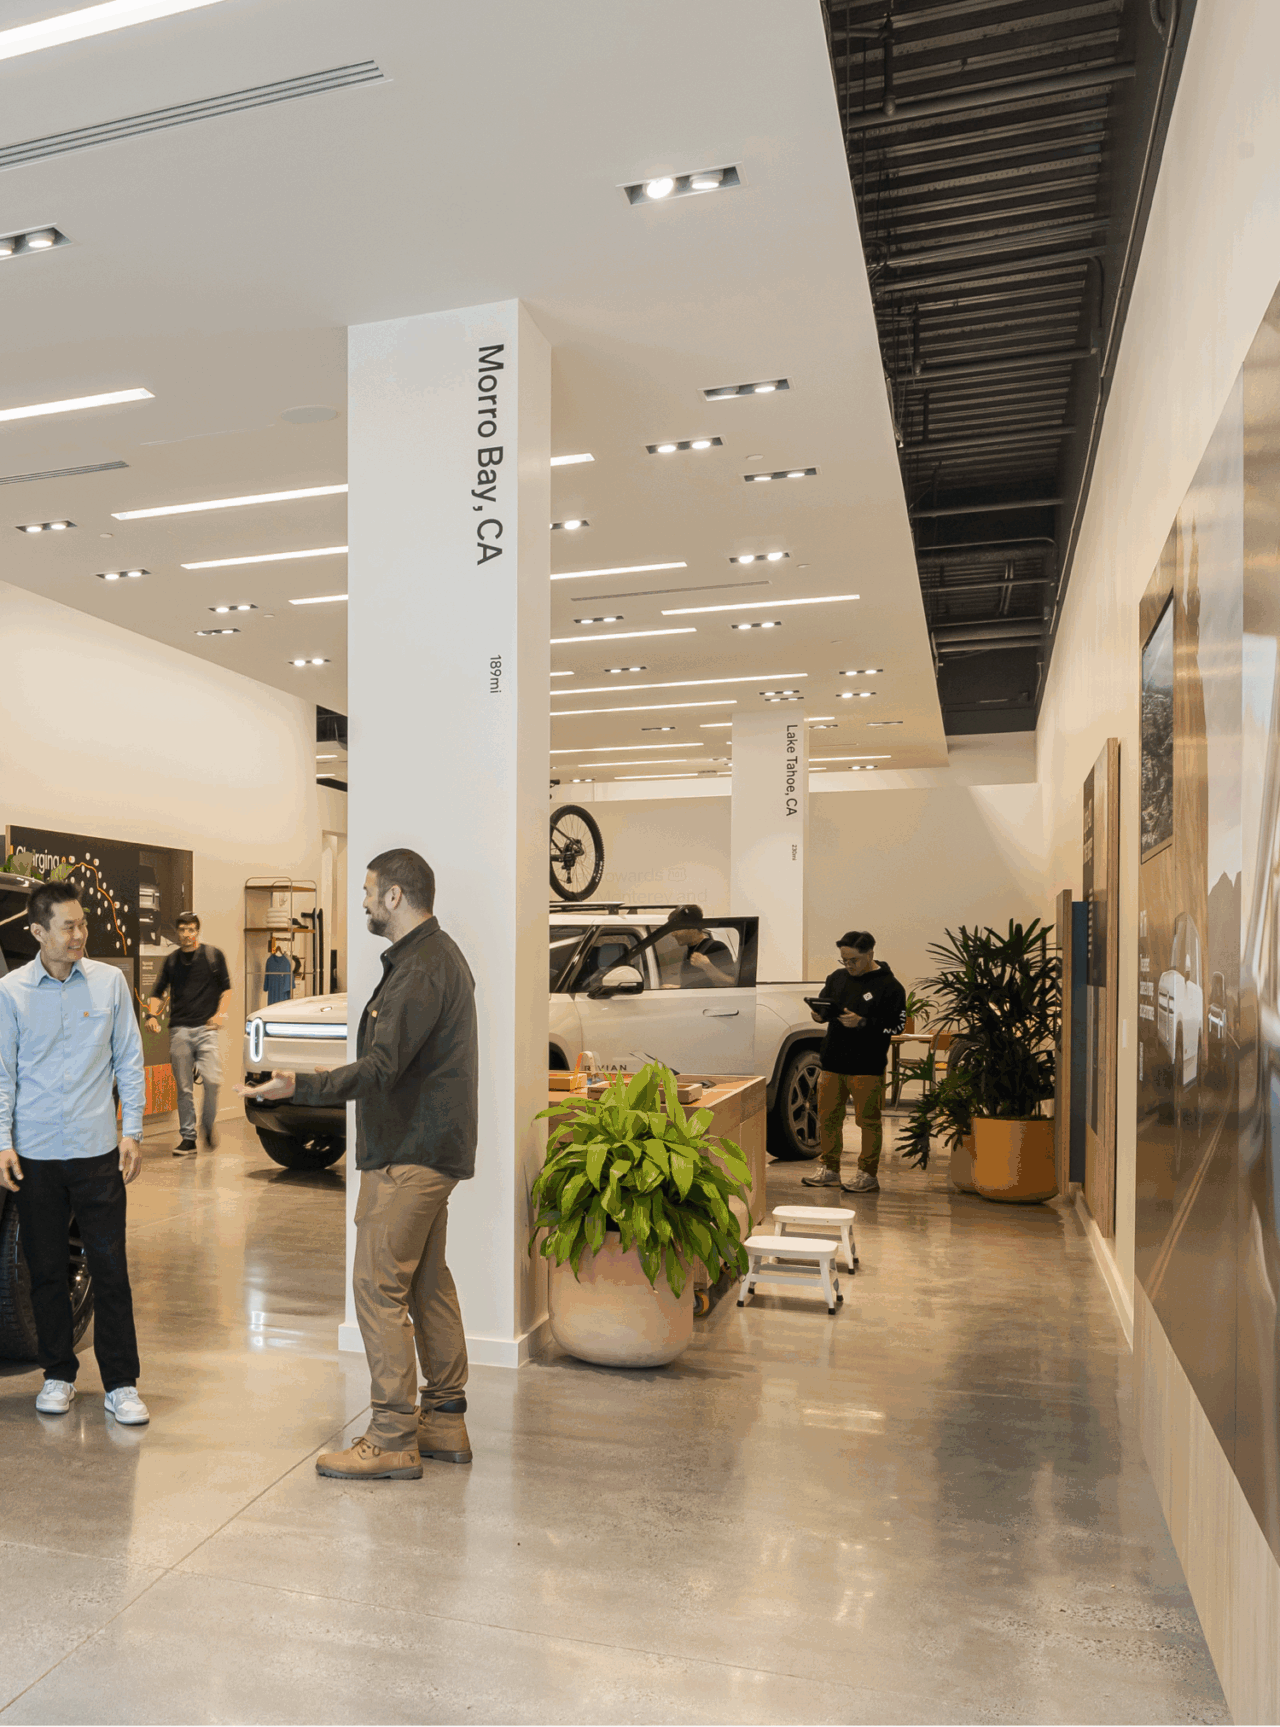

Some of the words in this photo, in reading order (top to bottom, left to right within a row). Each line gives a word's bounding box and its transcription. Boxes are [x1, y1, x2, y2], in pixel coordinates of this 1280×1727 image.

[477, 343, 505, 439] Morro
[470, 445, 504, 512] Bay,
[476, 518, 504, 566] CA
[489, 654, 502, 694] 189mi
[786, 724, 798, 754] Lake
[785, 755, 798, 796] Tahoe,
[786, 797, 798, 817] CA
[16, 845, 60, 875] Crging
[601, 867, 664, 883] owards
[596, 889, 671, 905] Monterey
[676, 888, 708, 903] and
